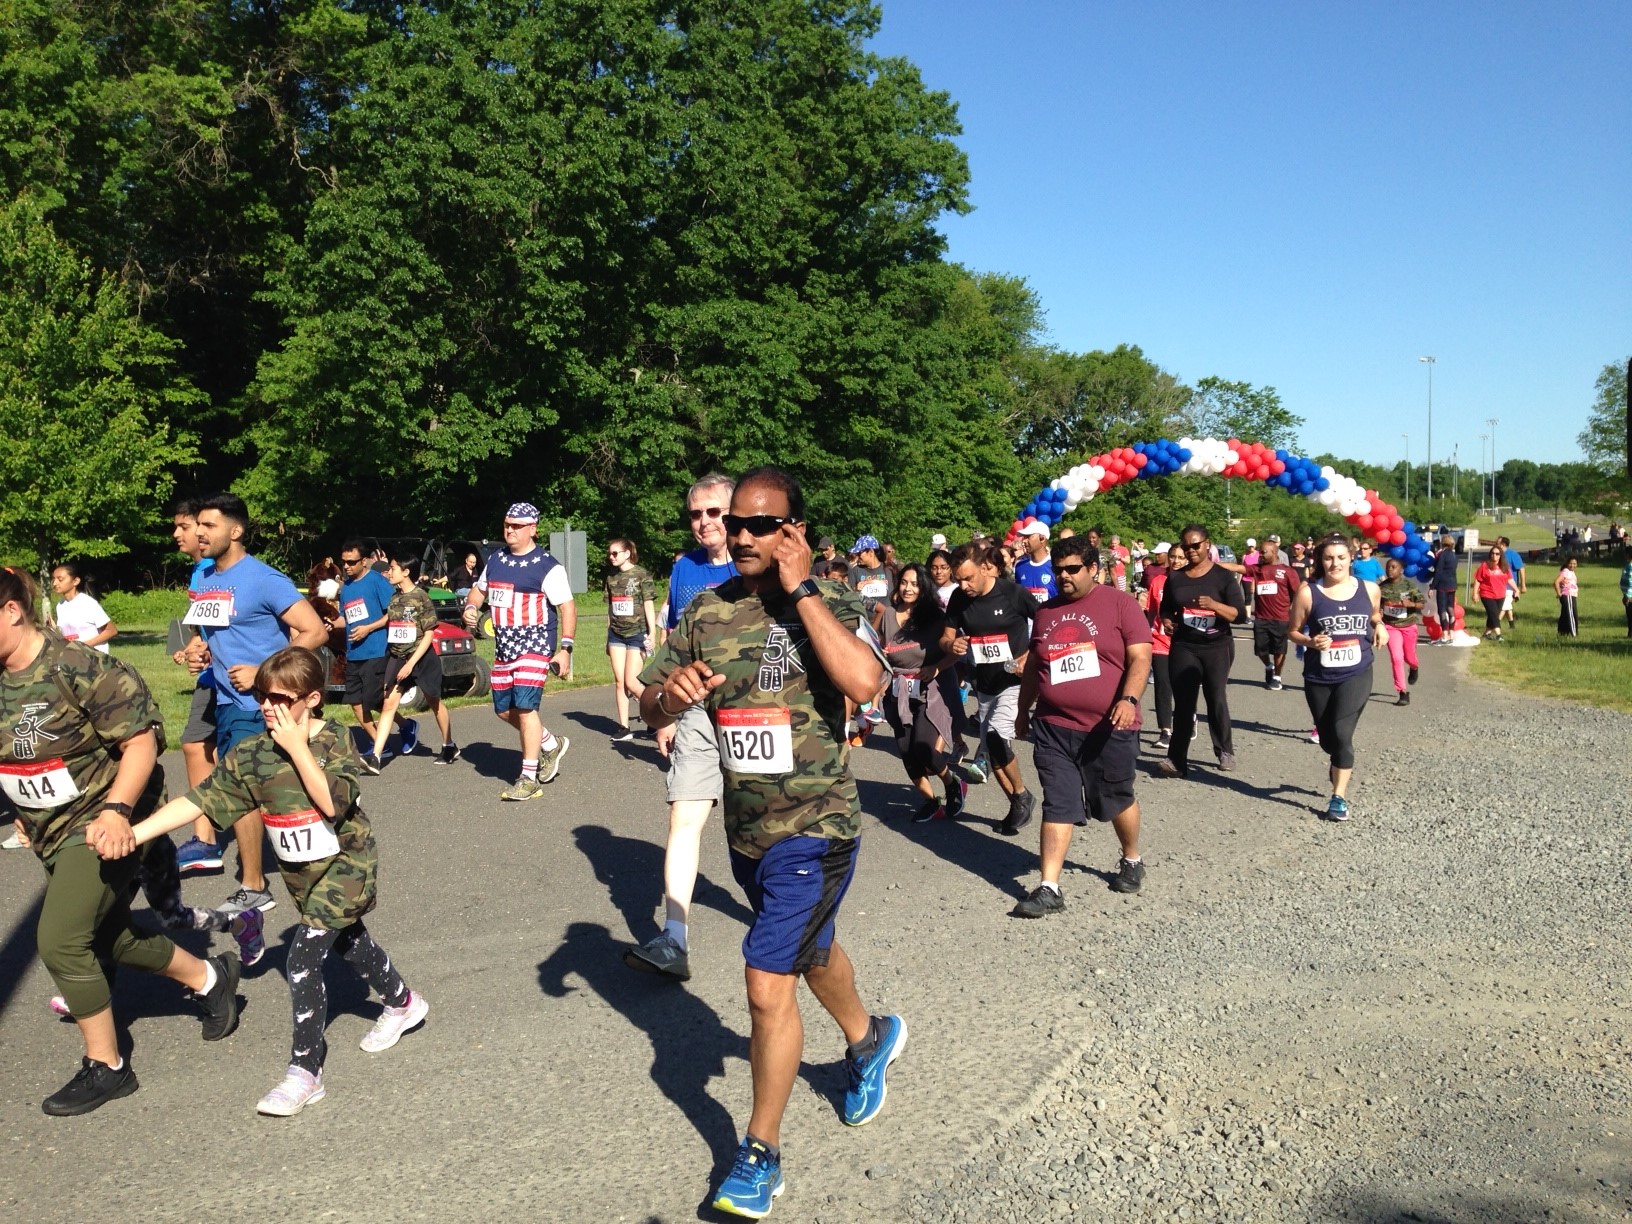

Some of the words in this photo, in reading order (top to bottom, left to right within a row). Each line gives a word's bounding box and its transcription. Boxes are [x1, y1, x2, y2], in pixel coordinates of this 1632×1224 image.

[192, 602, 220, 619] 1586
[1061, 612, 1077, 622] ALL
[1078, 614, 1099, 636] STARS
[1190, 615, 1208, 628] 473
[1317, 614, 1369, 632] PSU
[393, 628, 408, 639] 436
[762, 630, 808, 674] 5K
[982, 644, 1001, 658] 469
[1048, 643, 1068, 651] RUGBY
[1328, 648, 1354, 662] 1470
[1060, 655, 1085, 674] 462
[14, 709, 60, 745] 5K
[722, 730, 775, 761] 1520
[17, 775, 56, 800] 414
[280, 827, 312, 853] 417
